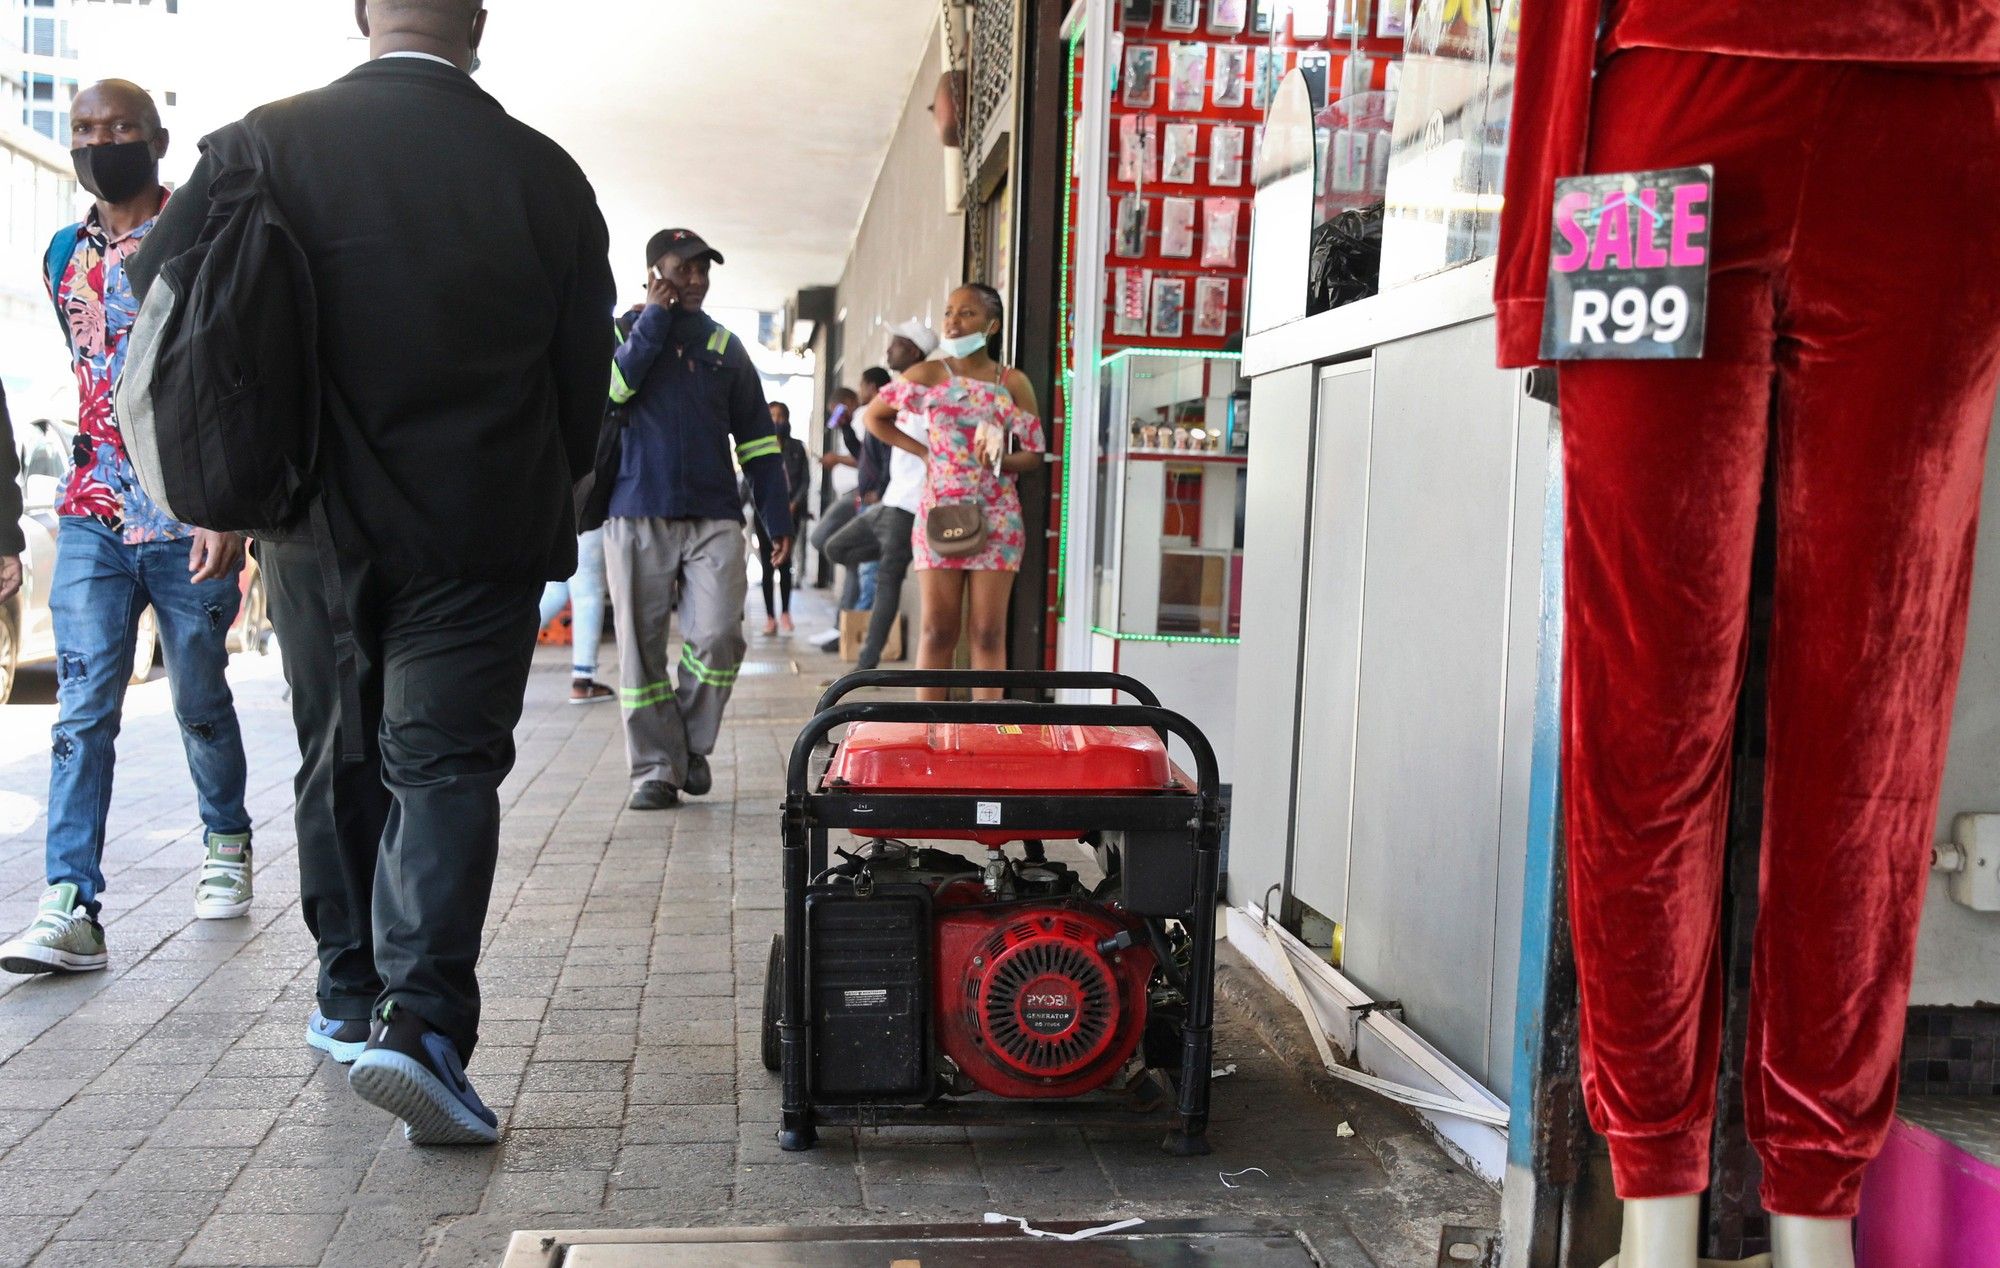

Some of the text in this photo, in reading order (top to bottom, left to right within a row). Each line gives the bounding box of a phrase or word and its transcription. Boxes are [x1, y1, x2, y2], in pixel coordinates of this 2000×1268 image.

[1552, 183, 1708, 272] SALE
[1569, 285, 1688, 344] R99
[1026, 994, 1068, 1006] RYOBI
